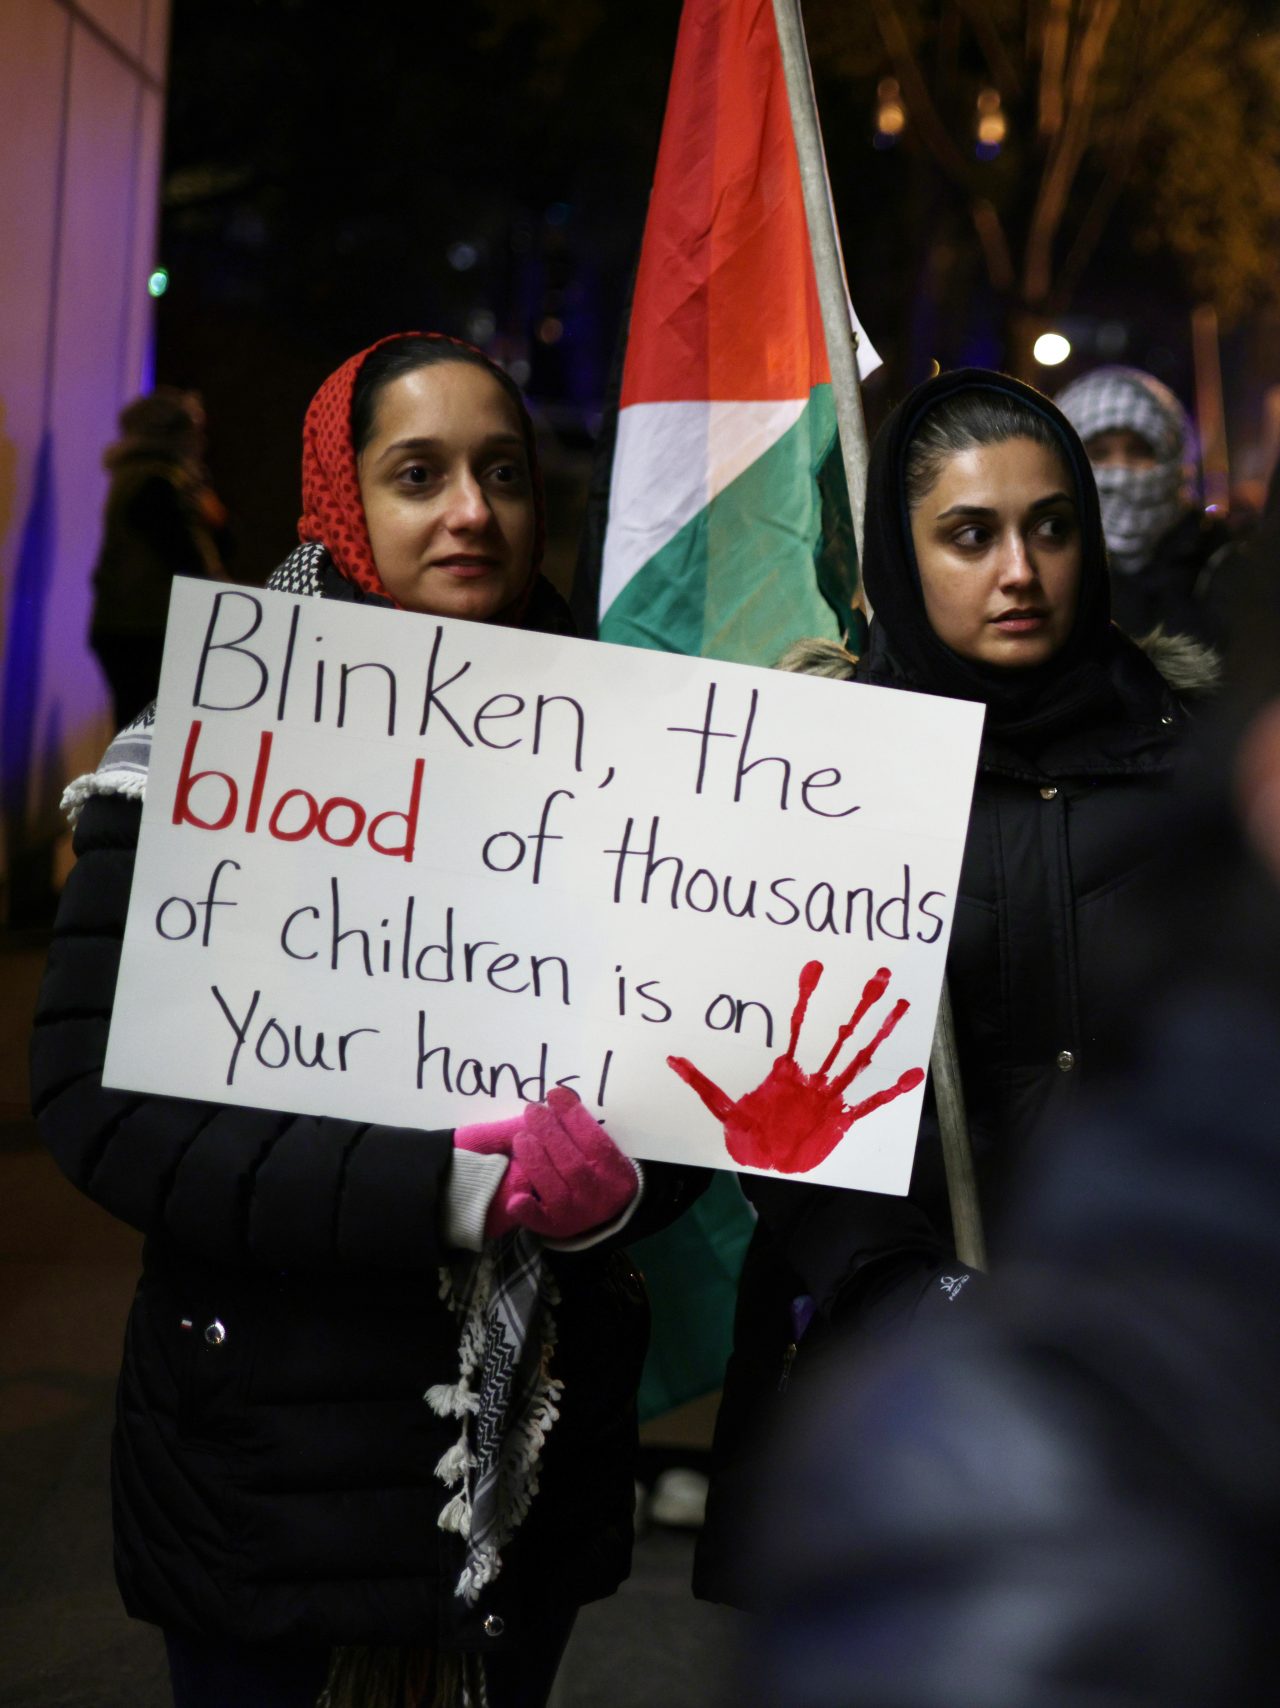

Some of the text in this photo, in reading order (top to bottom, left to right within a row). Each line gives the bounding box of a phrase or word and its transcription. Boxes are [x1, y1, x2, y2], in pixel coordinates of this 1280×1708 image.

[191, 590, 861, 818] Blinken, the
[172, 719, 946, 944] blood of thousands
[155, 859, 774, 1049] of children is on
